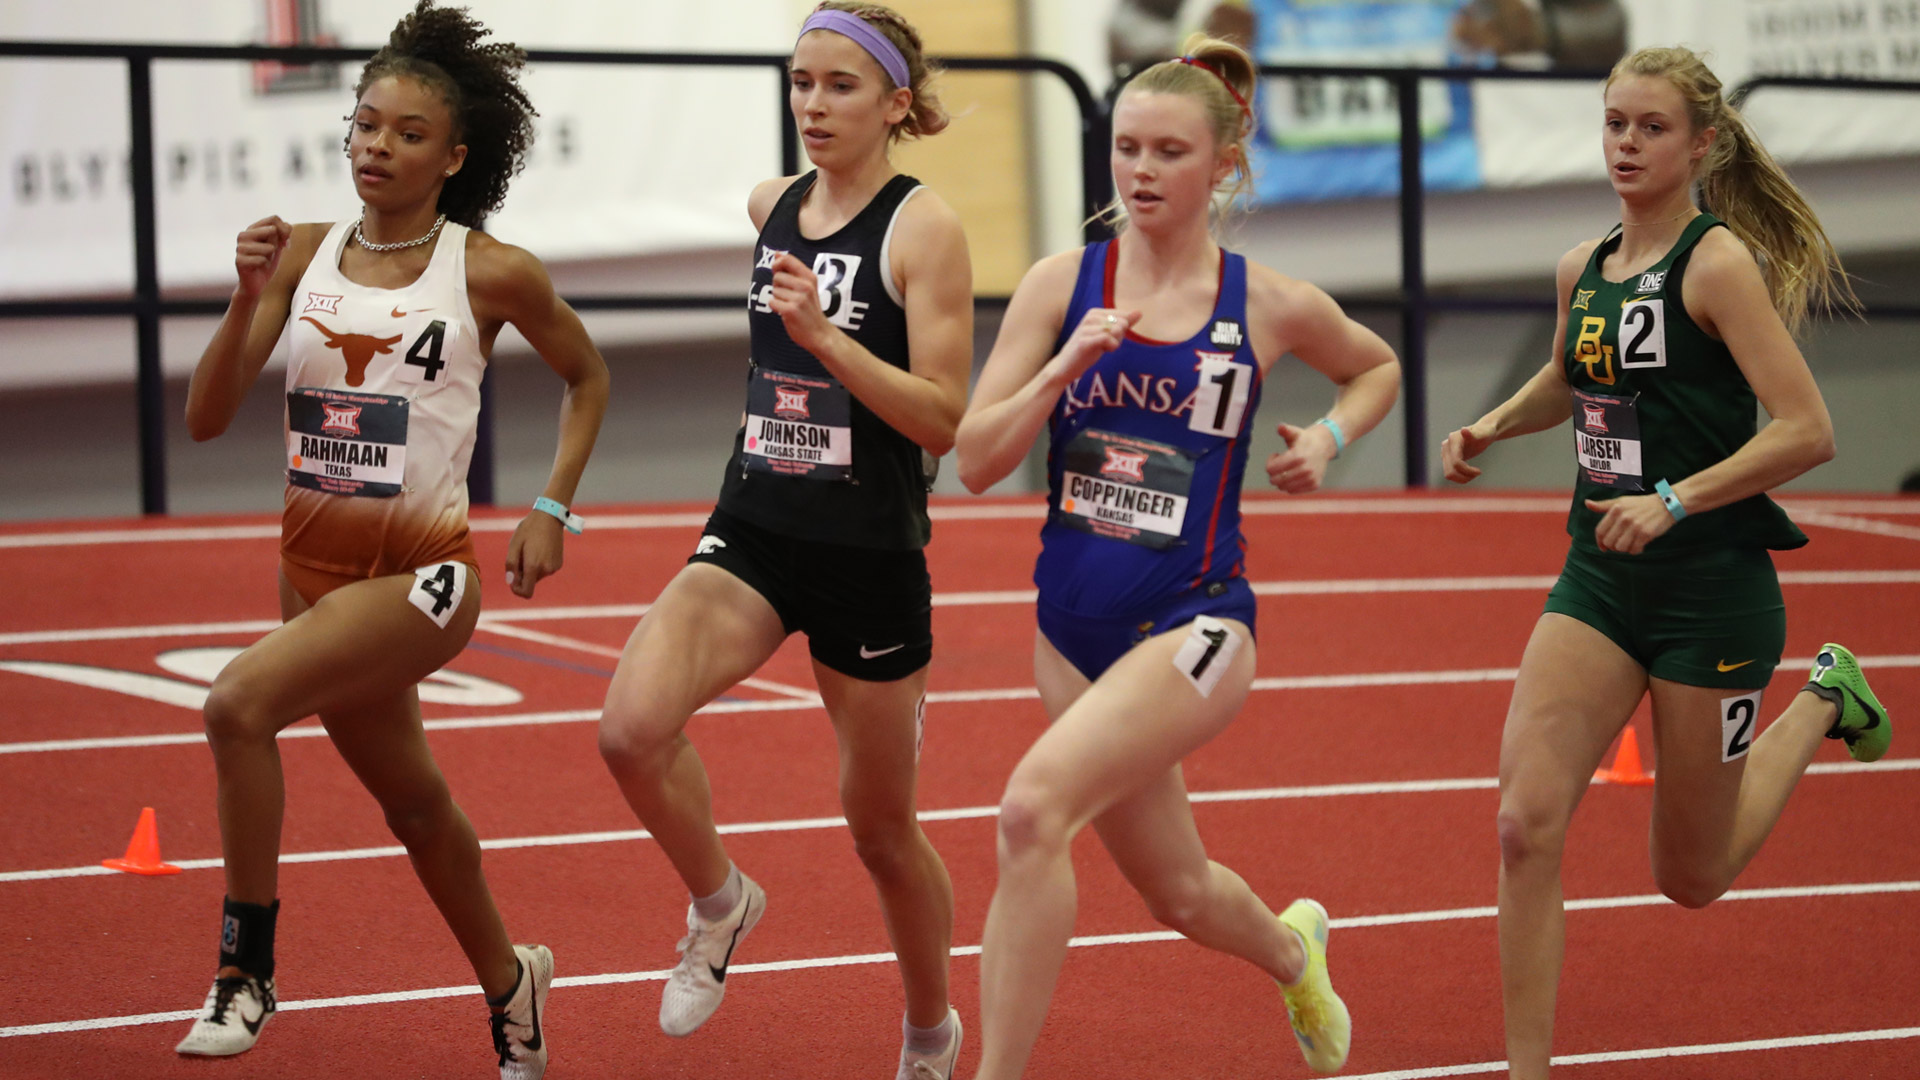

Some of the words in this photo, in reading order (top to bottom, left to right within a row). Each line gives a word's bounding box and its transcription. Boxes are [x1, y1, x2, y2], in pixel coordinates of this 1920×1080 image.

[14, 140, 254, 205] OLYPIC
[815, 258, 846, 318] 3
[1640, 272, 1664, 288] ONE
[404, 319, 446, 382] 4
[1624, 305, 1657, 363] 2
[1063, 371, 1200, 417] KANSA
[1211, 368, 1239, 431] 1
[324, 408, 358, 431] XII
[759, 419, 831, 449] JOHNSON
[300, 435, 388, 468] RAHMAAN
[764, 443, 795, 459] KANSAS
[797, 447, 822, 461] STATE
[1581, 434, 1622, 460] LARSEN
[324, 463, 352, 478] TEXAS
[1070, 475, 1175, 518] COPPINGER
[1096, 506, 1135, 524] KANSAS
[420, 564, 455, 617] 4
[1191, 628, 1229, 681] 1
[1726, 698, 1755, 757] 2
